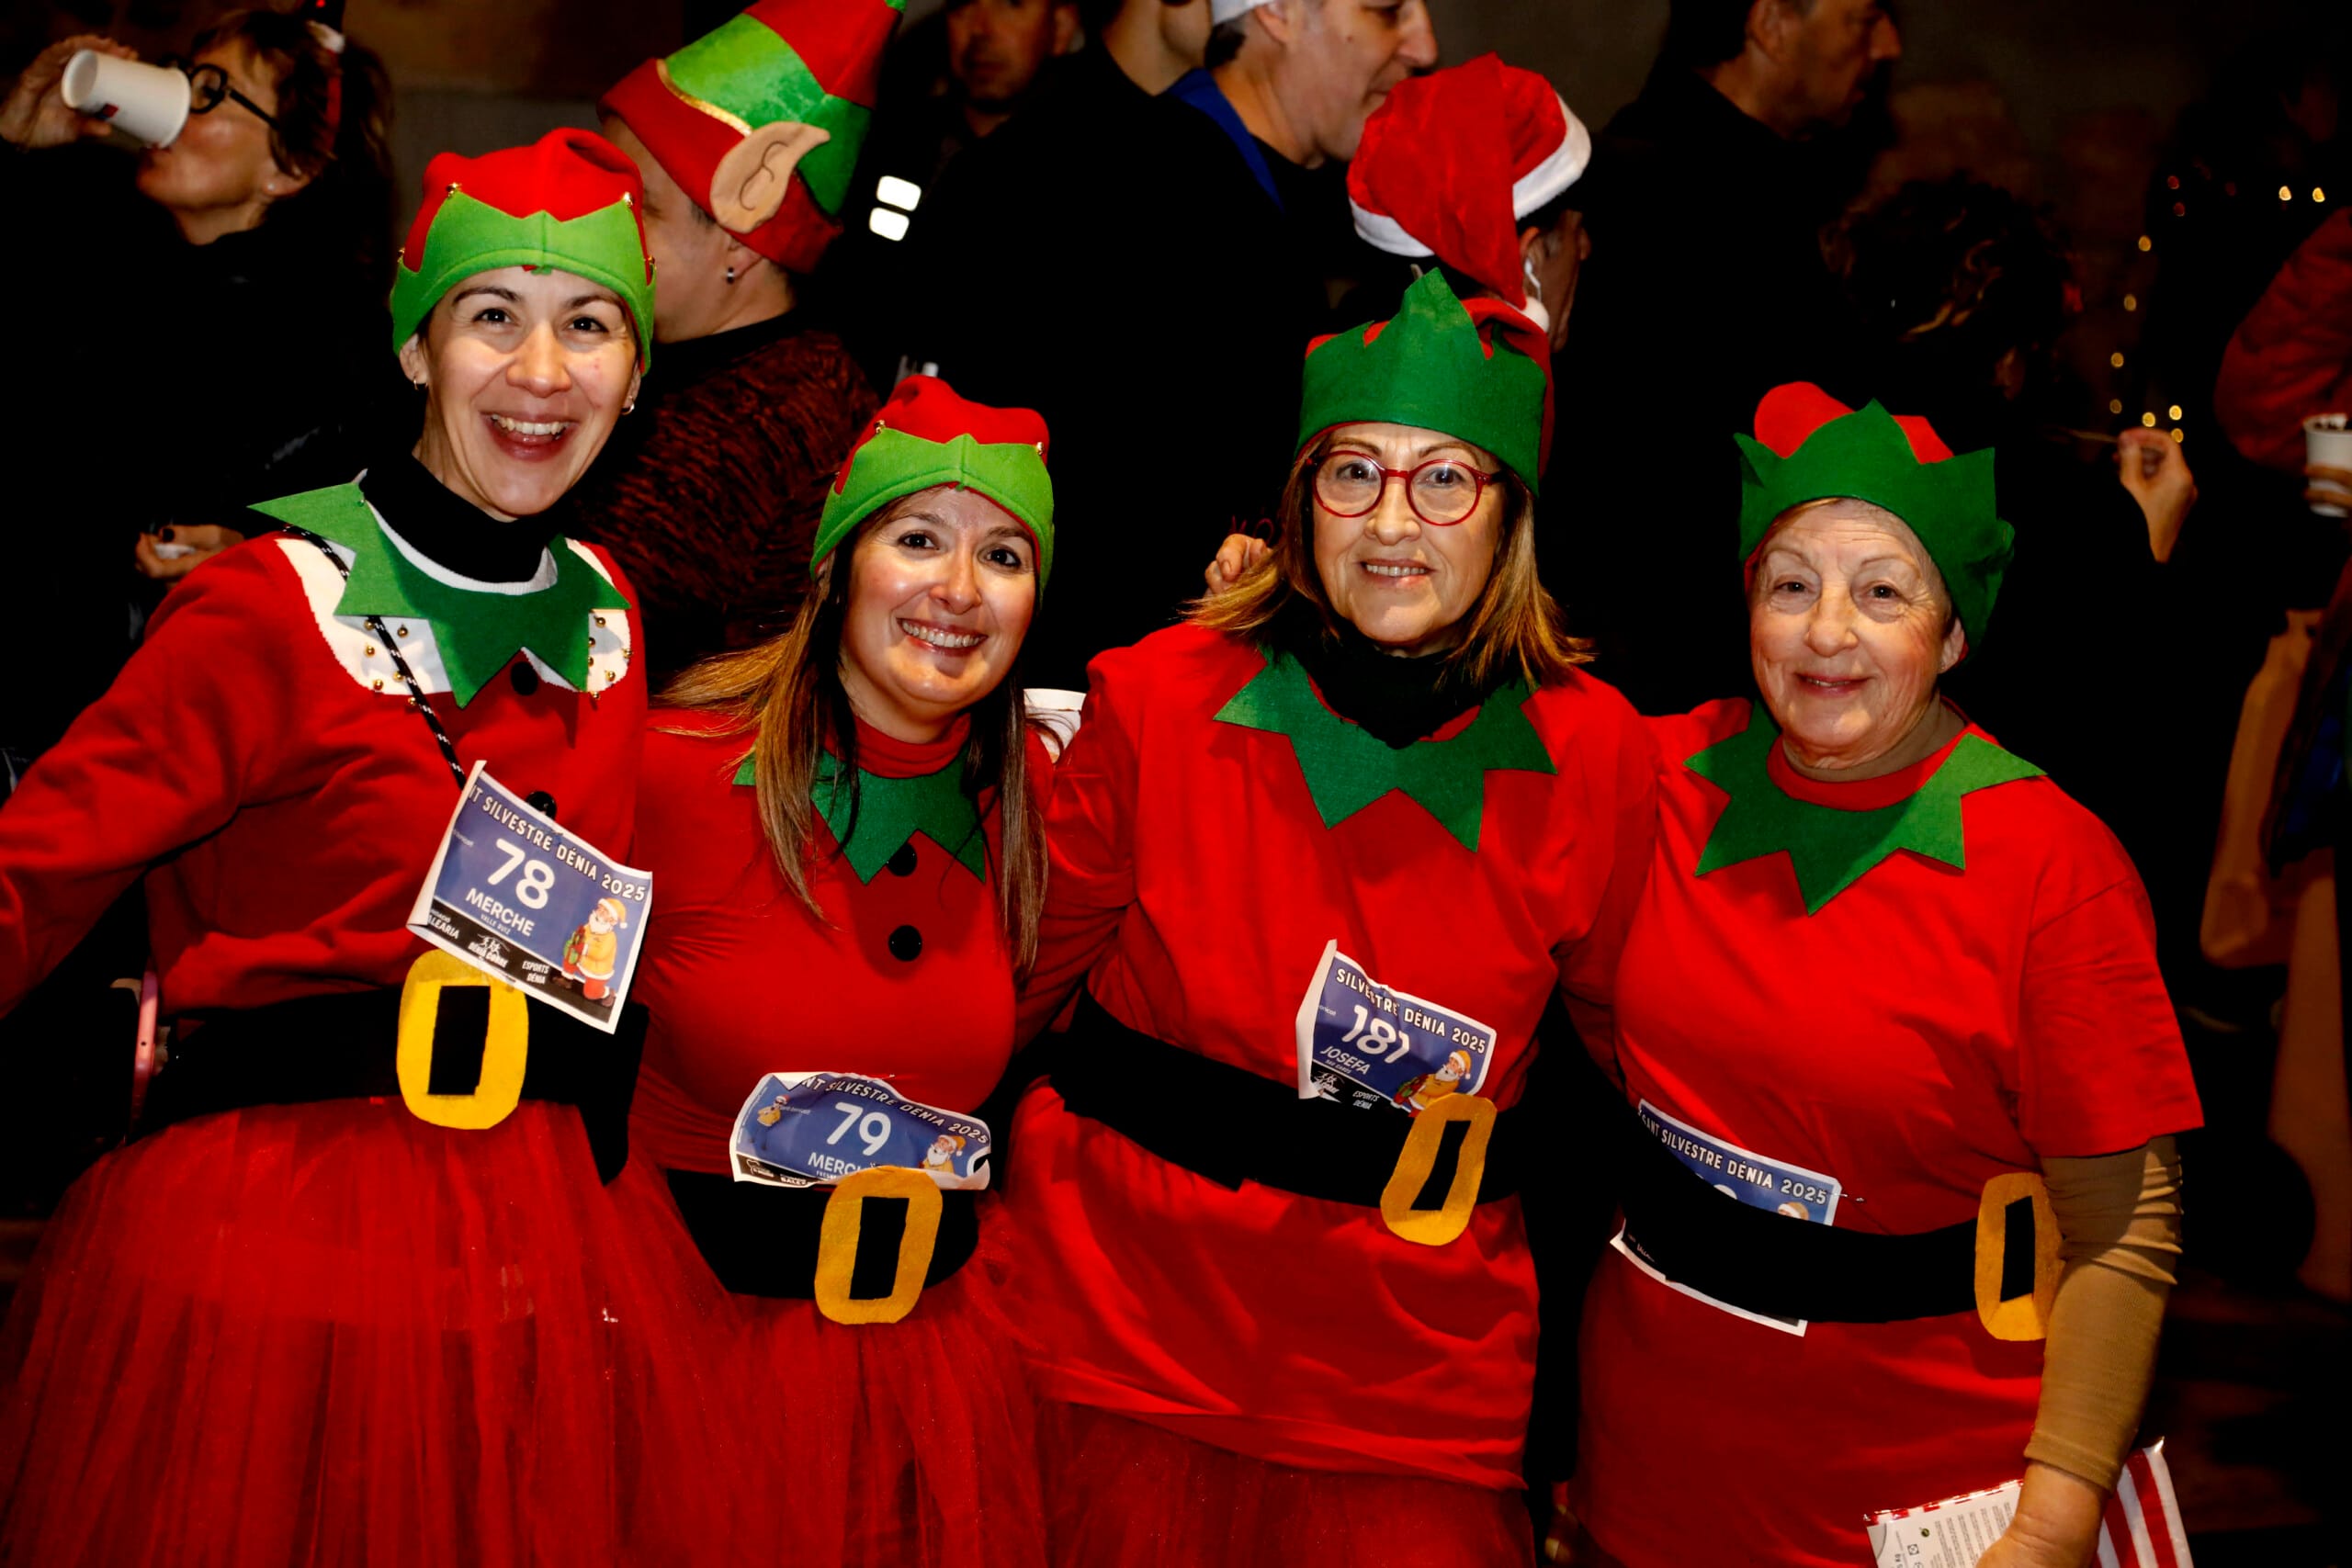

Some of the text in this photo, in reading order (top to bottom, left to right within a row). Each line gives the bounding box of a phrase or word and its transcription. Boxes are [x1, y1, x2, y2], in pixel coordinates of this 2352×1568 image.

[481, 795, 553, 852] SILVESTRE
[555, 846, 597, 881] DÉNIA
[601, 874, 647, 901] 2025
[486, 838, 556, 910] 78
[464, 886, 536, 937] MERCHE
[521, 959, 550, 975] ESPORTS
[1336, 967, 1487, 1055] SILVESTRE DÉNIA 2025
[1319, 1045, 1371, 1075] JOSEFA
[825, 1079, 896, 1106] SILVESTRE
[899, 1102, 945, 1127] DÉNIA
[947, 1122, 989, 1145] 2025
[1351, 1089, 1381, 1102] ESPORTS
[826, 1101, 891, 1157] 79
[807, 1151, 862, 1176] MERC
[1660, 1128, 1724, 1169] SILVESTRE
[1726, 1159, 1773, 1190] DÉNIA
[1781, 1178, 1828, 1205] 2025
